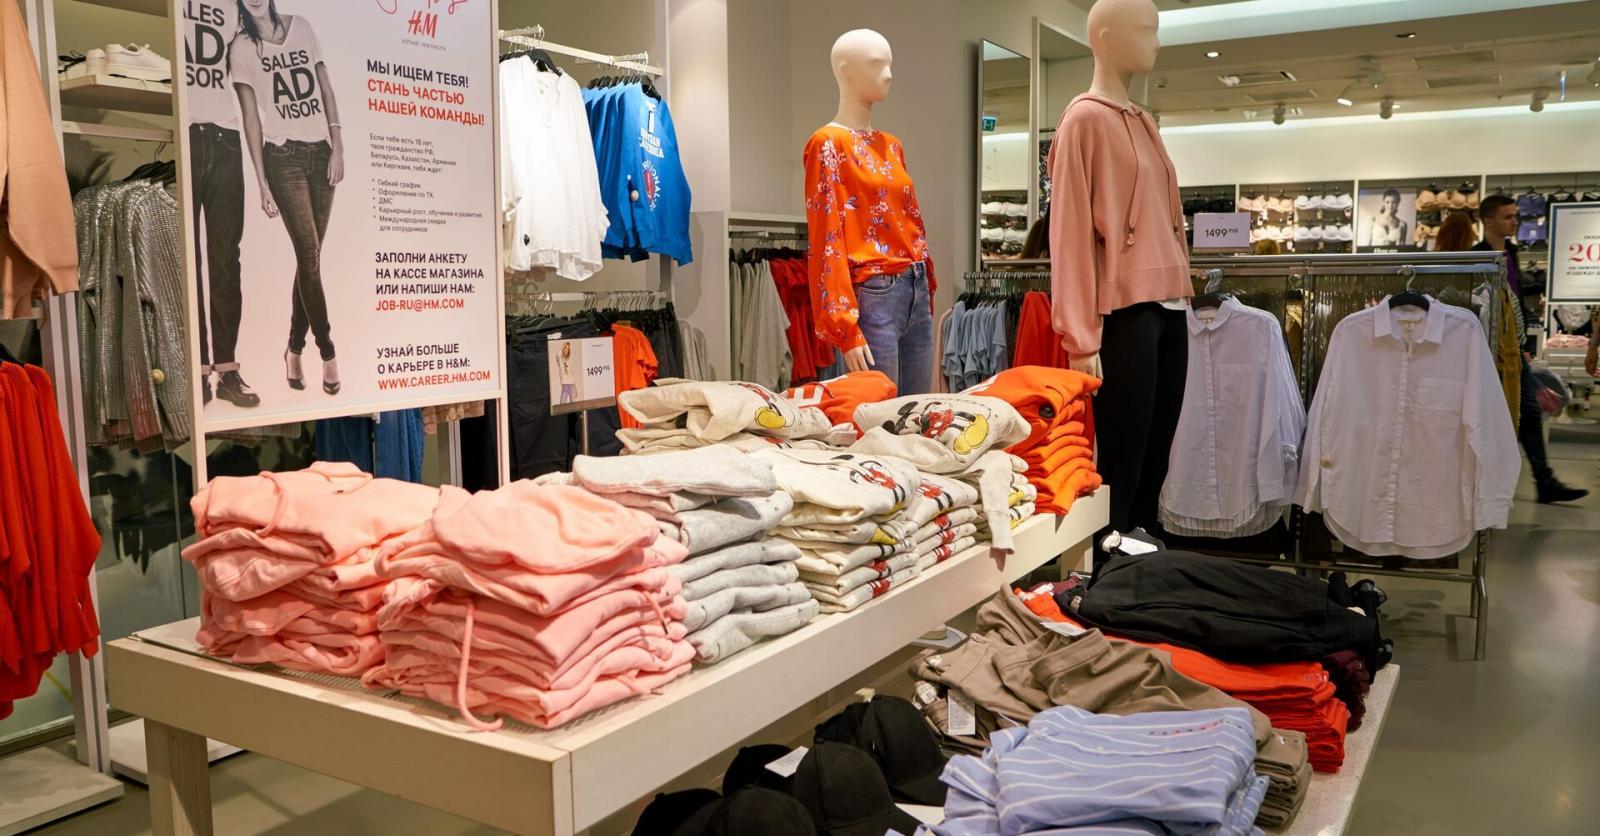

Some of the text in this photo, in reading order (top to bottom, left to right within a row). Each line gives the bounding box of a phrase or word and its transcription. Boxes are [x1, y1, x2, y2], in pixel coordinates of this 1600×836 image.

[183, 0, 225, 27] LES
[261, 50, 309, 73] SALES
[367, 59, 470, 88] МЫ ИЩЕМ ТЕБЯ!
[273, 66, 315, 104] AD
[367, 79, 465, 105] СТАНЬ ЧАСТЬЮ
[275, 98, 321, 120] VISOR
[368, 98, 485, 127] НАШЕЙ КОМАНДЫ!
[369, 133, 385, 141] Если
[385, 145, 424, 154] гражданство
[371, 152, 401, 161] Беларусь,
[378, 179, 421, 189] Гибкий график
[378, 188, 417, 198] Оформление
[378, 197, 393, 205] ДМС
[379, 207, 412, 215] Карьерный
[428, 209, 453, 217] обучение
[379, 215, 427, 224] Международная
[1205, 228, 1228, 238] 1499
[375, 252, 467, 264] ЗАПОЛНИ АНКЕТУ
[376, 268, 484, 279] НА КАССЕ МАГАЗИНА
[376, 283, 475, 295] ИЛИ НАПИШИ НАМ:
[376, 298, 465, 312] JOB-RU@HM.COM
[377, 343, 459, 358] УЗНАЙ БОЛЬШЕ
[377, 358, 471, 374] О КАРЬЕРЕ В H&M:
[586, 366, 603, 376] 1499
[378, 370, 491, 390] WWW.CAREER.HM.COM
